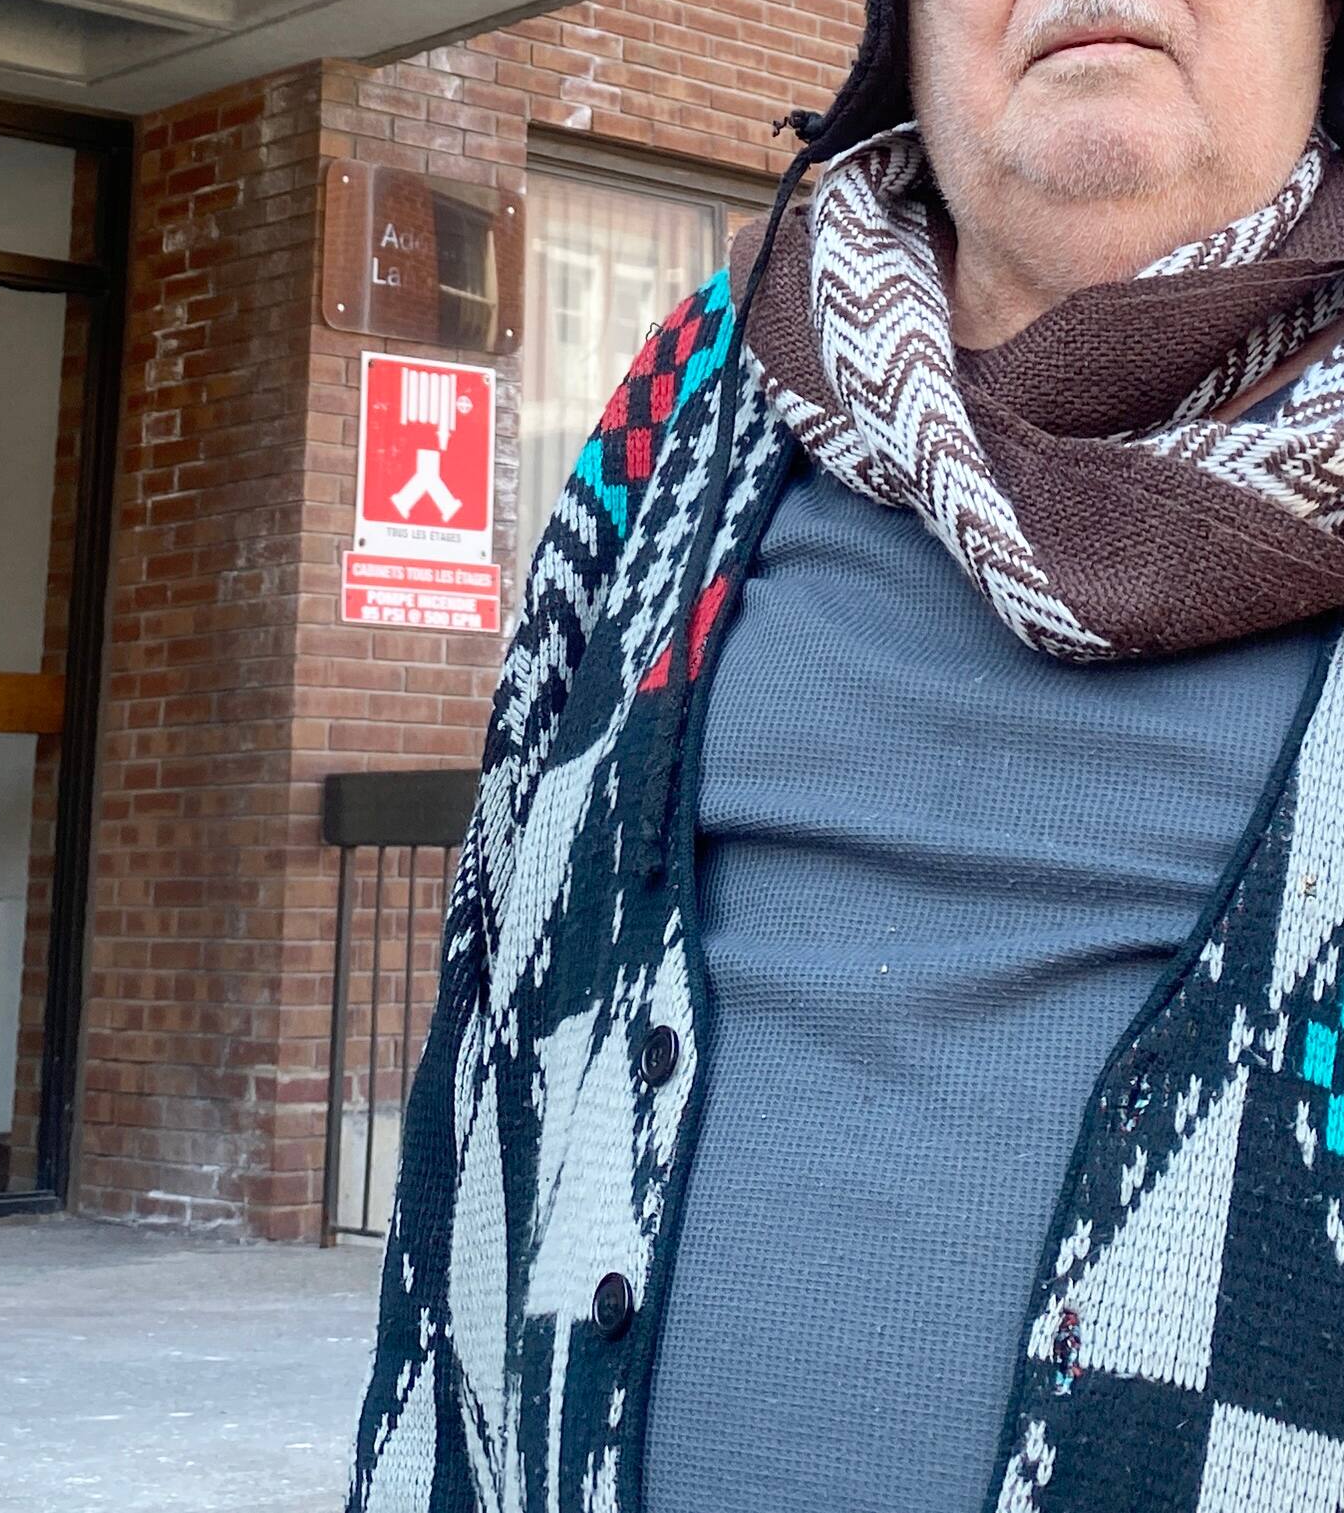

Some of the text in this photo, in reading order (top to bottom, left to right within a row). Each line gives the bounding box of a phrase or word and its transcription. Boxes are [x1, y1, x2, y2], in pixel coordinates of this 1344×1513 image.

[407, 566, 433, 582] TOUS
[435, 568, 454, 584] LES
[367, 590, 477, 612] POMPE INCENDIE
